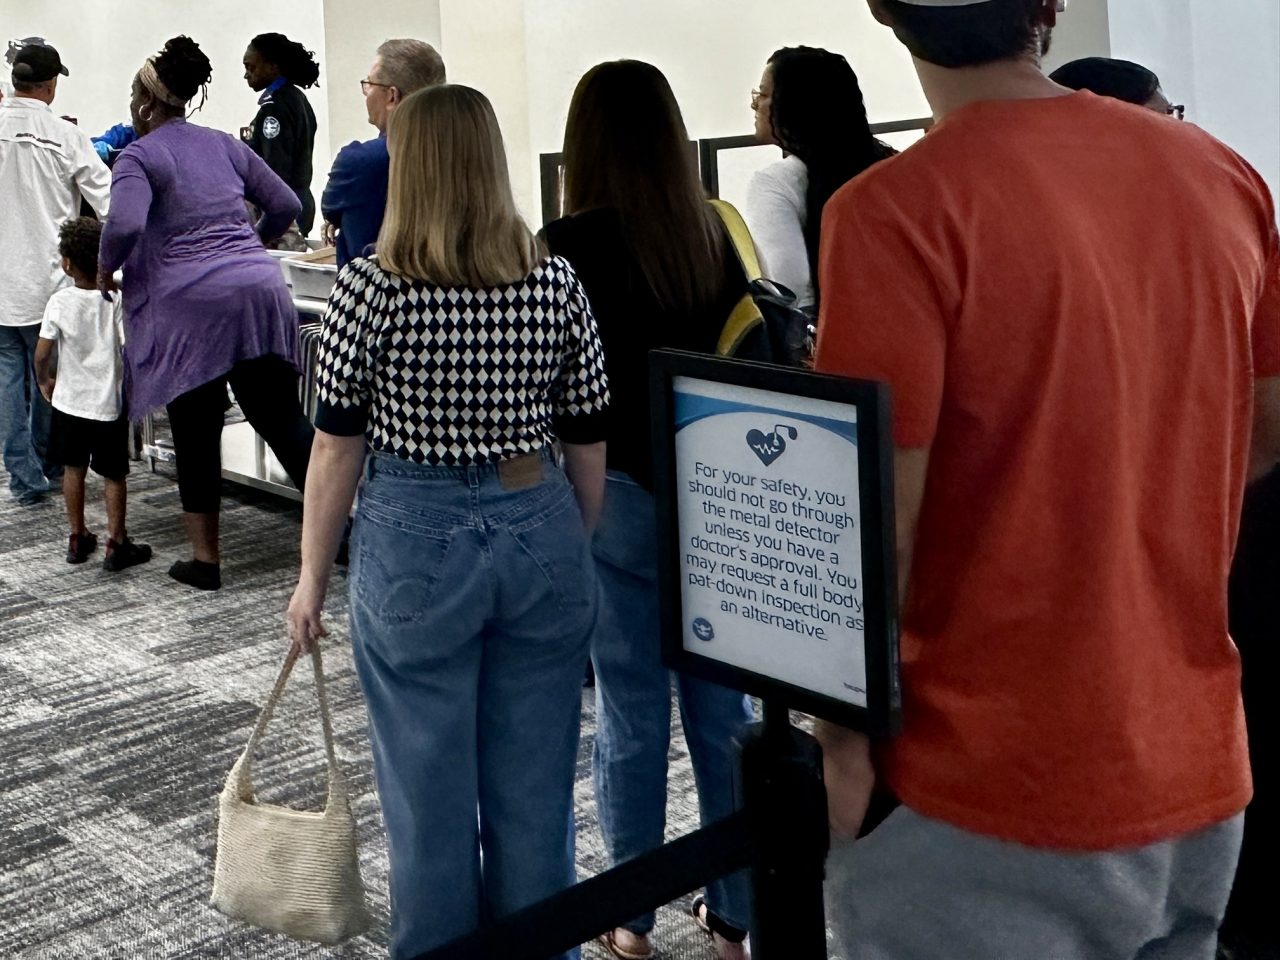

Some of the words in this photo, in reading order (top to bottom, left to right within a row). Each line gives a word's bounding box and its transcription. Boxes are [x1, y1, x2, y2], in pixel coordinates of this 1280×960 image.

[688, 480, 736, 502] should
[741, 492, 765, 509] not
[769, 499, 788, 513] go
[792, 501, 854, 529] through
[695, 462, 718, 478] For
[722, 469, 757, 486] your
[815, 489, 846, 506] you
[702, 500, 726, 517] the
[730, 508, 770, 529] metal
[775, 518, 840, 544] detector
[704, 521, 750, 543] unless
[753, 533, 782, 550] you
[786, 538, 825, 561] have
[829, 552, 839, 565] a
[686, 554, 717, 573] may
[721, 563, 776, 589] request
[780, 578, 789, 592] a
[794, 579, 817, 599] full
[822, 586, 862, 613] body
[691, 535, 747, 561] doctor's
[750, 552, 822, 580] approval.
[826, 568, 857, 589] You
[688, 573, 757, 602] pat-down
[761, 589, 841, 626] inspection
[845, 615, 864, 631] as
[720, 600, 738, 614] an
